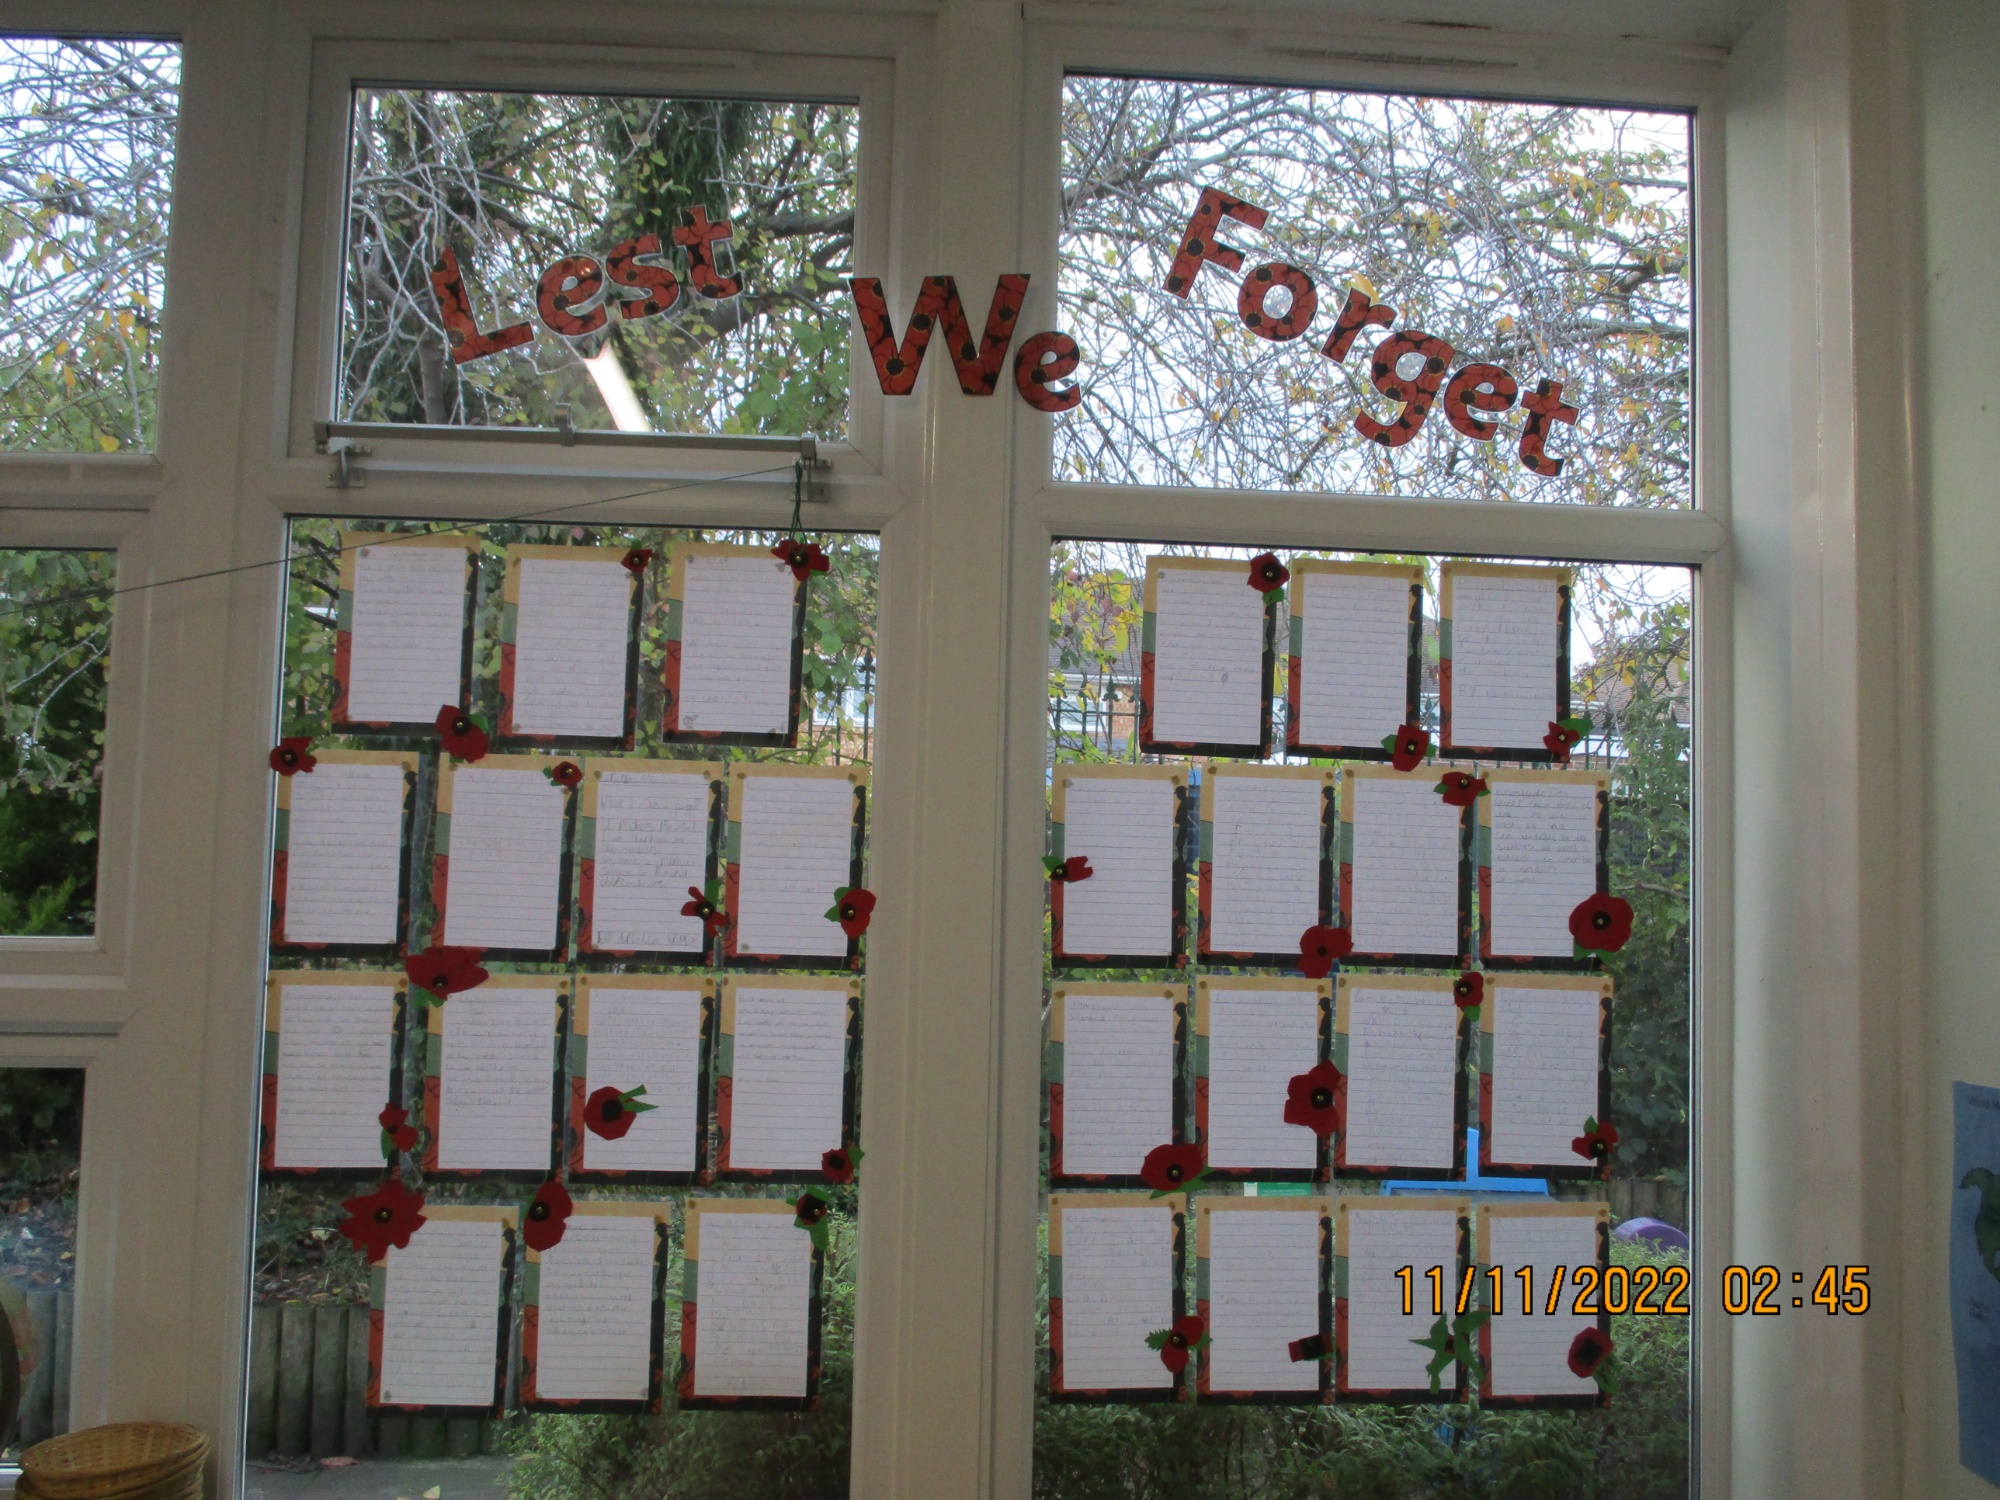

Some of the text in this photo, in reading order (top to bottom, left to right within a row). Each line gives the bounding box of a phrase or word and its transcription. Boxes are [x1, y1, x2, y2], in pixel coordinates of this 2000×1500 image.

[430, 185, 1580, 477] Lest We Forget
